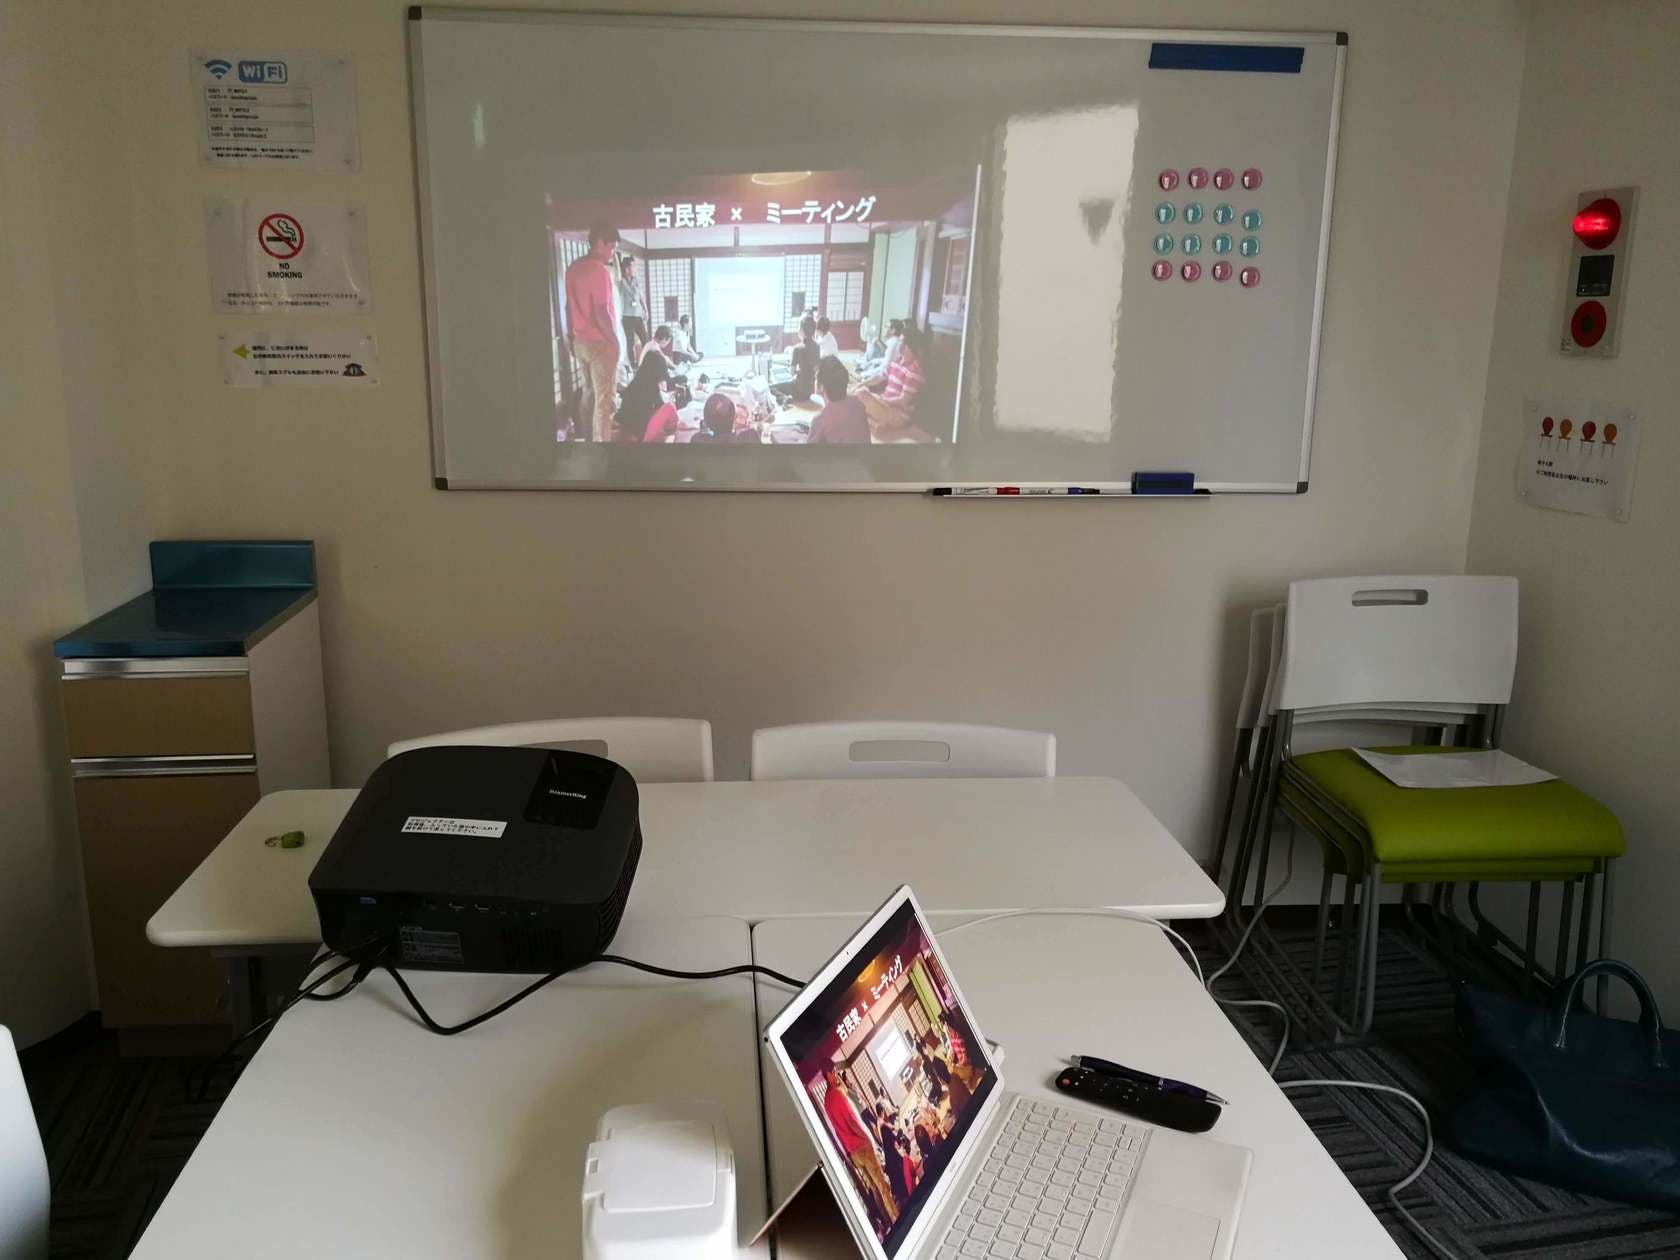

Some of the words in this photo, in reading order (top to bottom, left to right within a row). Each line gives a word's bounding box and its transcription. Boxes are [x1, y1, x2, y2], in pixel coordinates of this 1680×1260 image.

[653, 202, 716, 229] 古民家
[766, 196, 877, 223] ミーティング
[267, 271, 303, 279] SMOKING
[278, 262, 290, 270] NO
[836, 1007, 861, 1042] 古民家
[870, 954, 903, 1000] ミーティング
